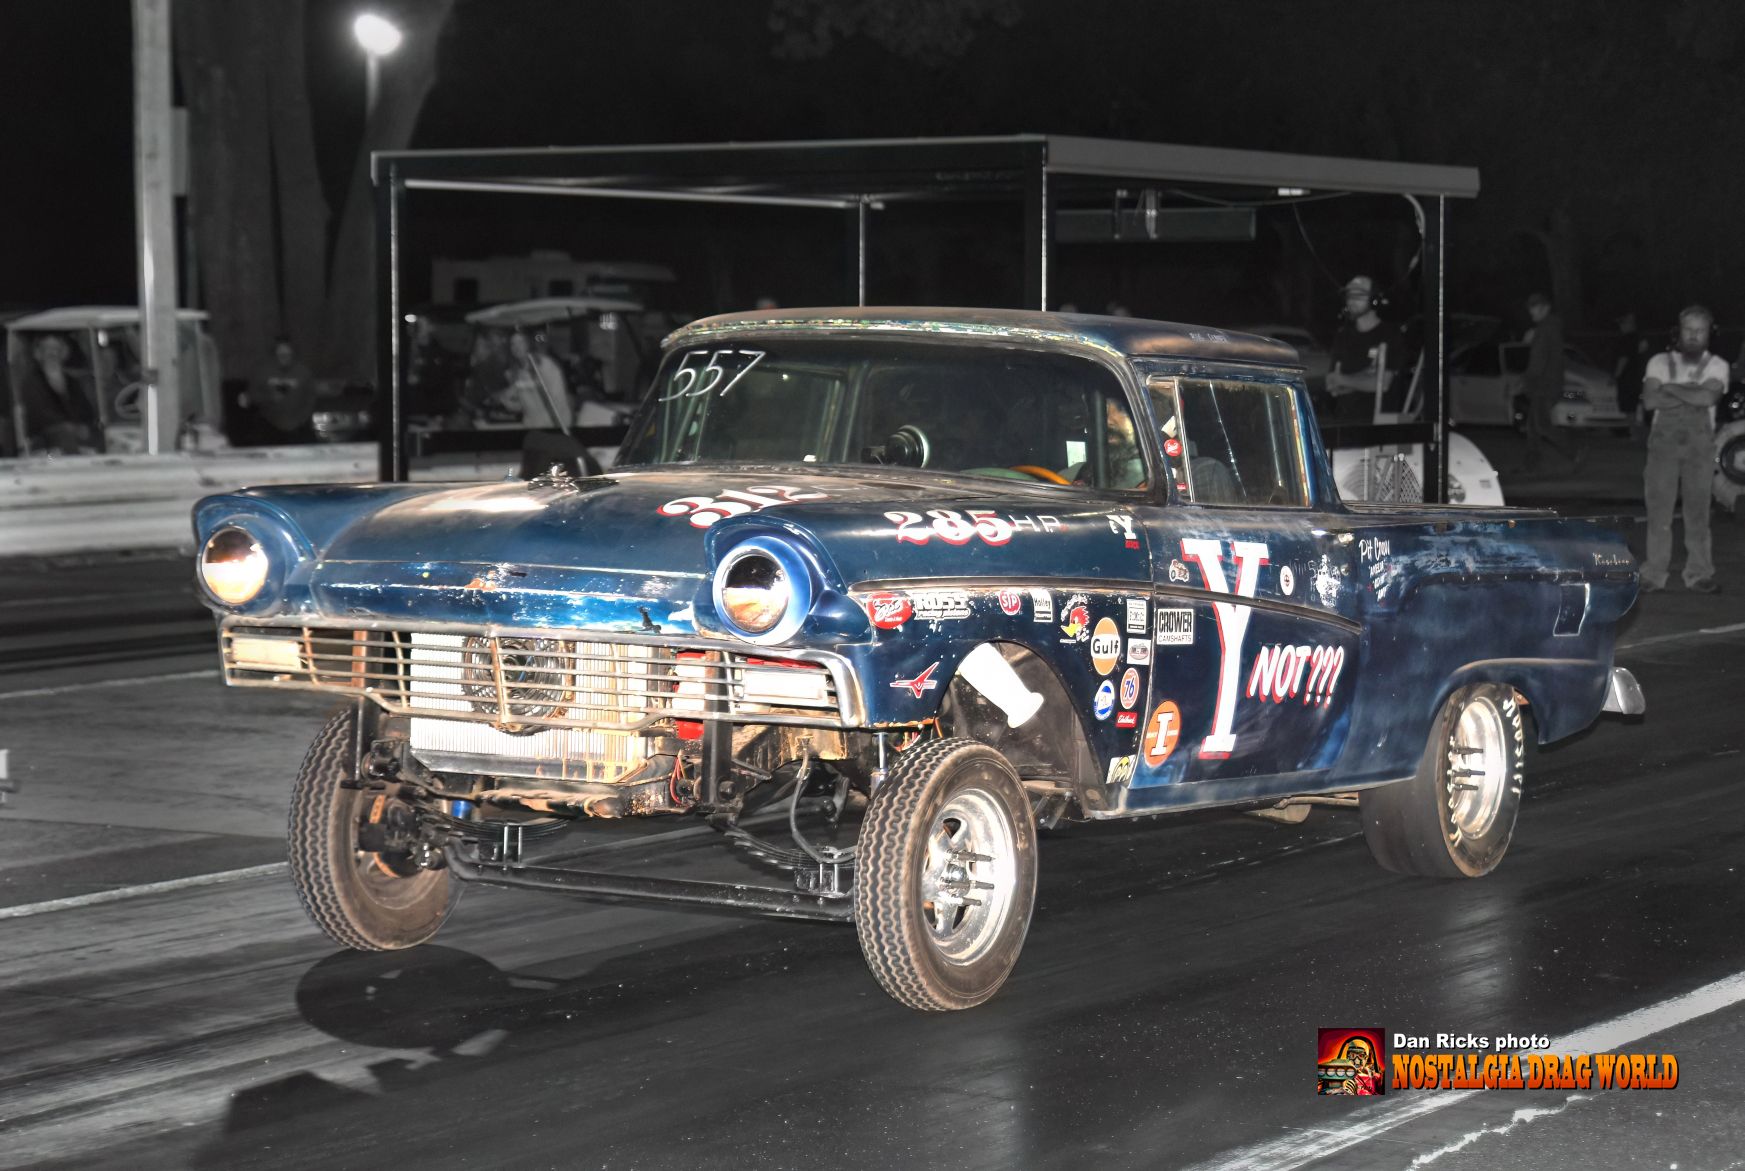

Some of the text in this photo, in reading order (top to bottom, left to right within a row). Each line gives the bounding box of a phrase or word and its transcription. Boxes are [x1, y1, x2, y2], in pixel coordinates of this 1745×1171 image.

[658, 349, 766, 402] 557
[656, 485, 831, 528] 312
[883, 509, 1014, 546] 285
[1358, 539, 1373, 564] Pit
[1001, 593, 1019, 609] STP
[1158, 611, 1192, 632] CROWER
[1092, 638, 1120, 655] Gulf
[1157, 634, 1192, 643] CAMSHAFTS
[1180, 537, 1270, 759] Y
[1124, 678, 1136, 699] 76
[1246, 645, 1345, 709] NOT???
